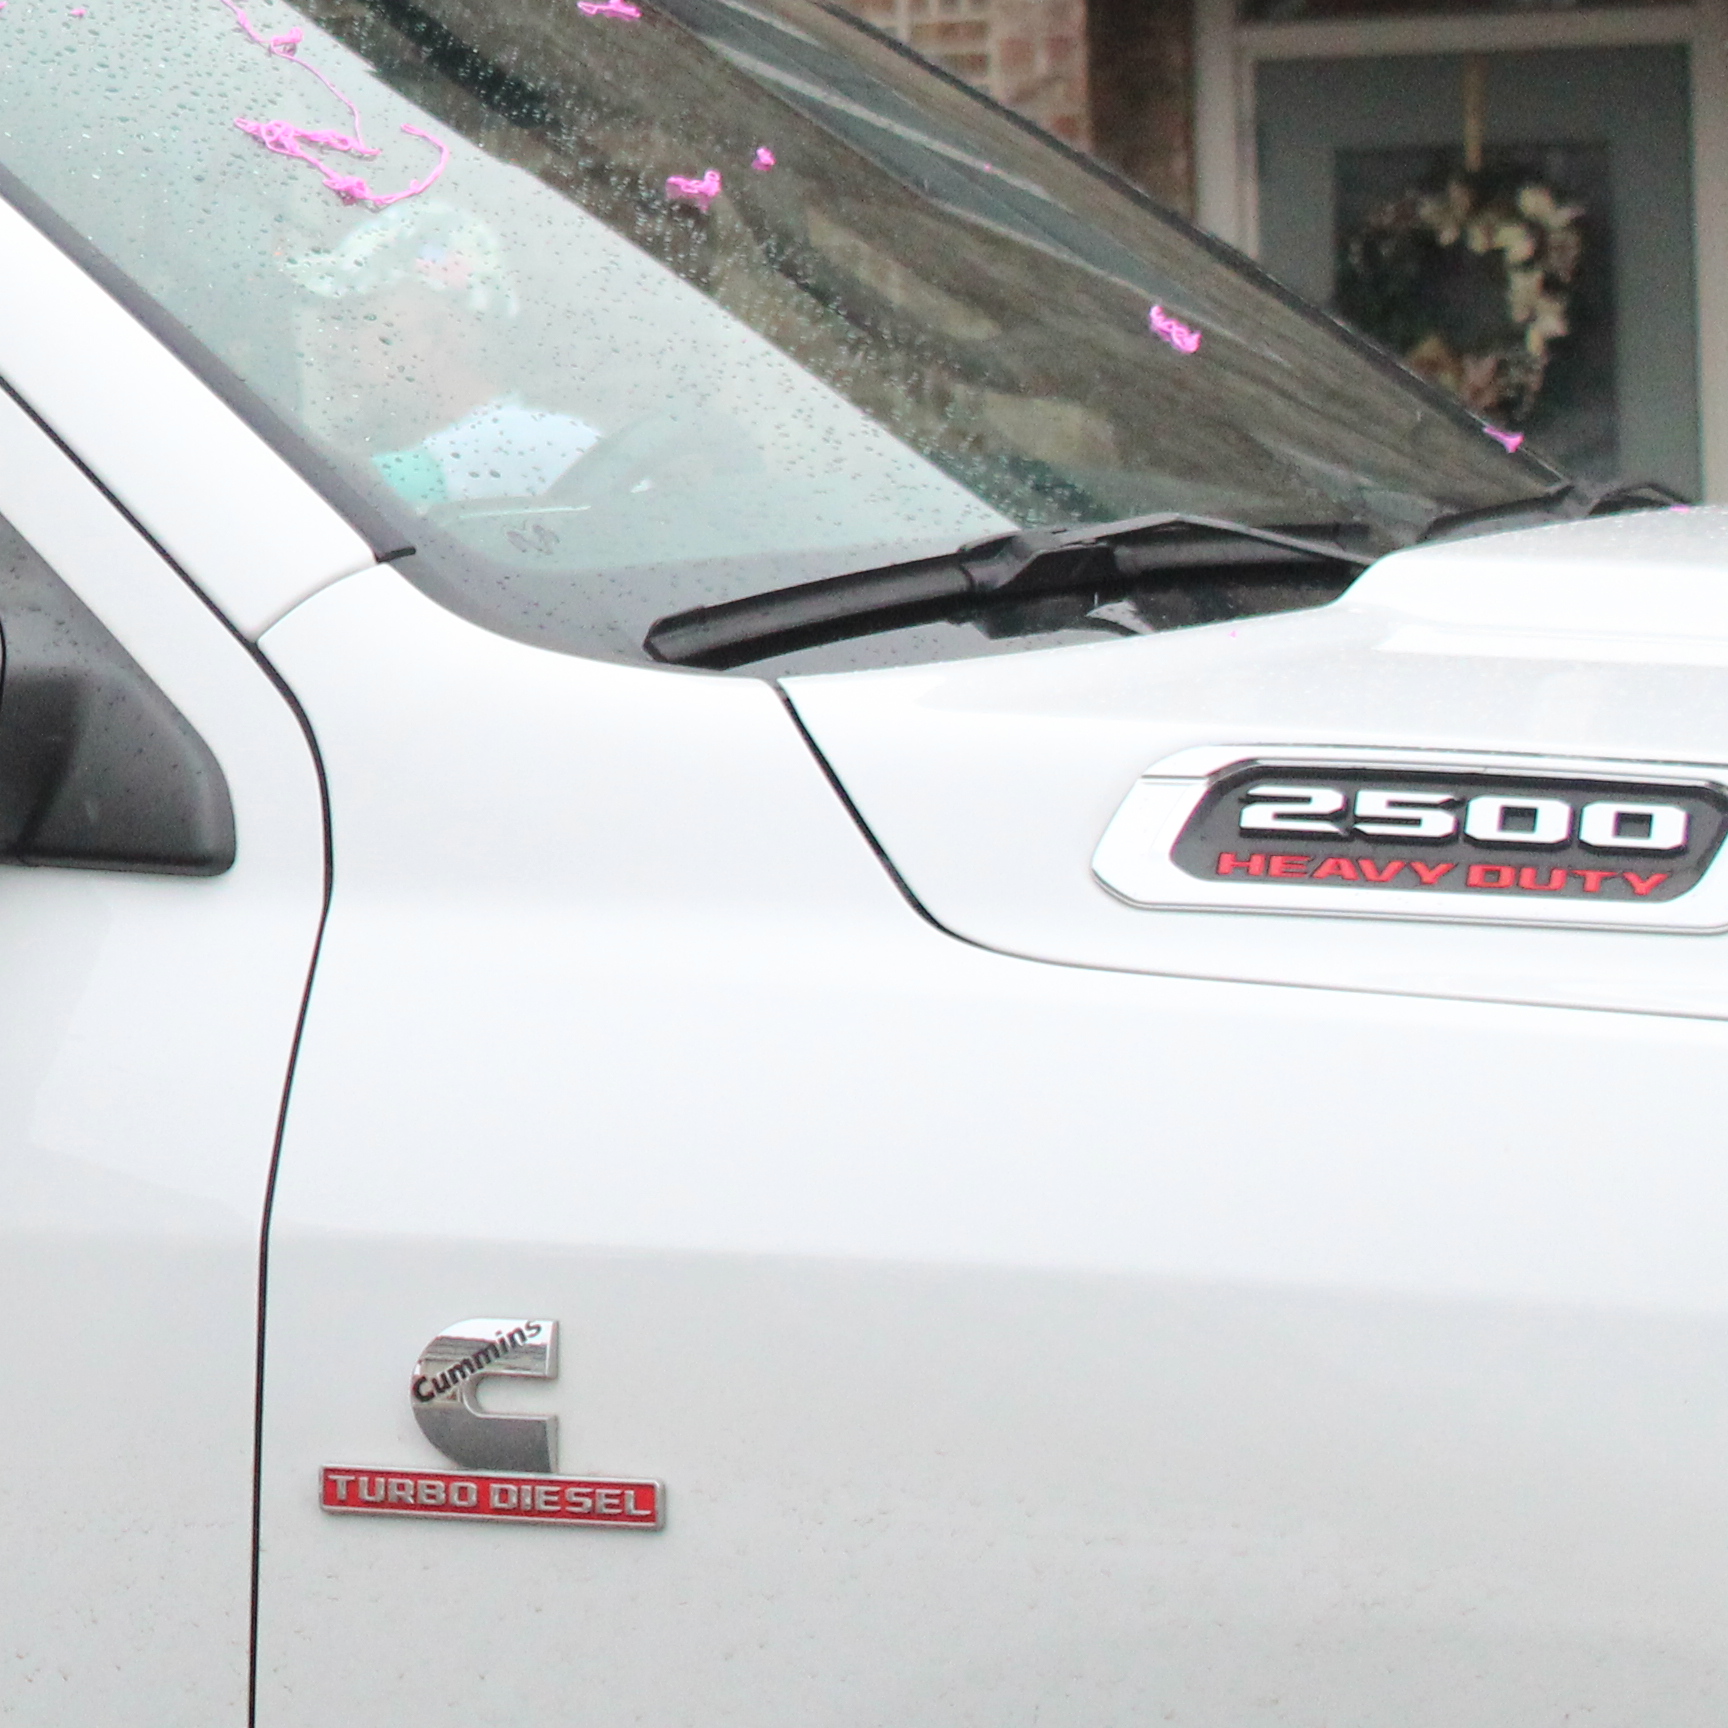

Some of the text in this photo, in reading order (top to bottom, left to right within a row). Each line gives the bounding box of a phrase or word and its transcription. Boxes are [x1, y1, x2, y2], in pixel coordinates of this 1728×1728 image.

[1239, 784, 1689, 854] 2500
[1215, 851, 1670, 897] HEAVY DUTY
[411, 1318, 544, 1404] Cummins
[327, 1473, 652, 1517] TURBO DIESEL
